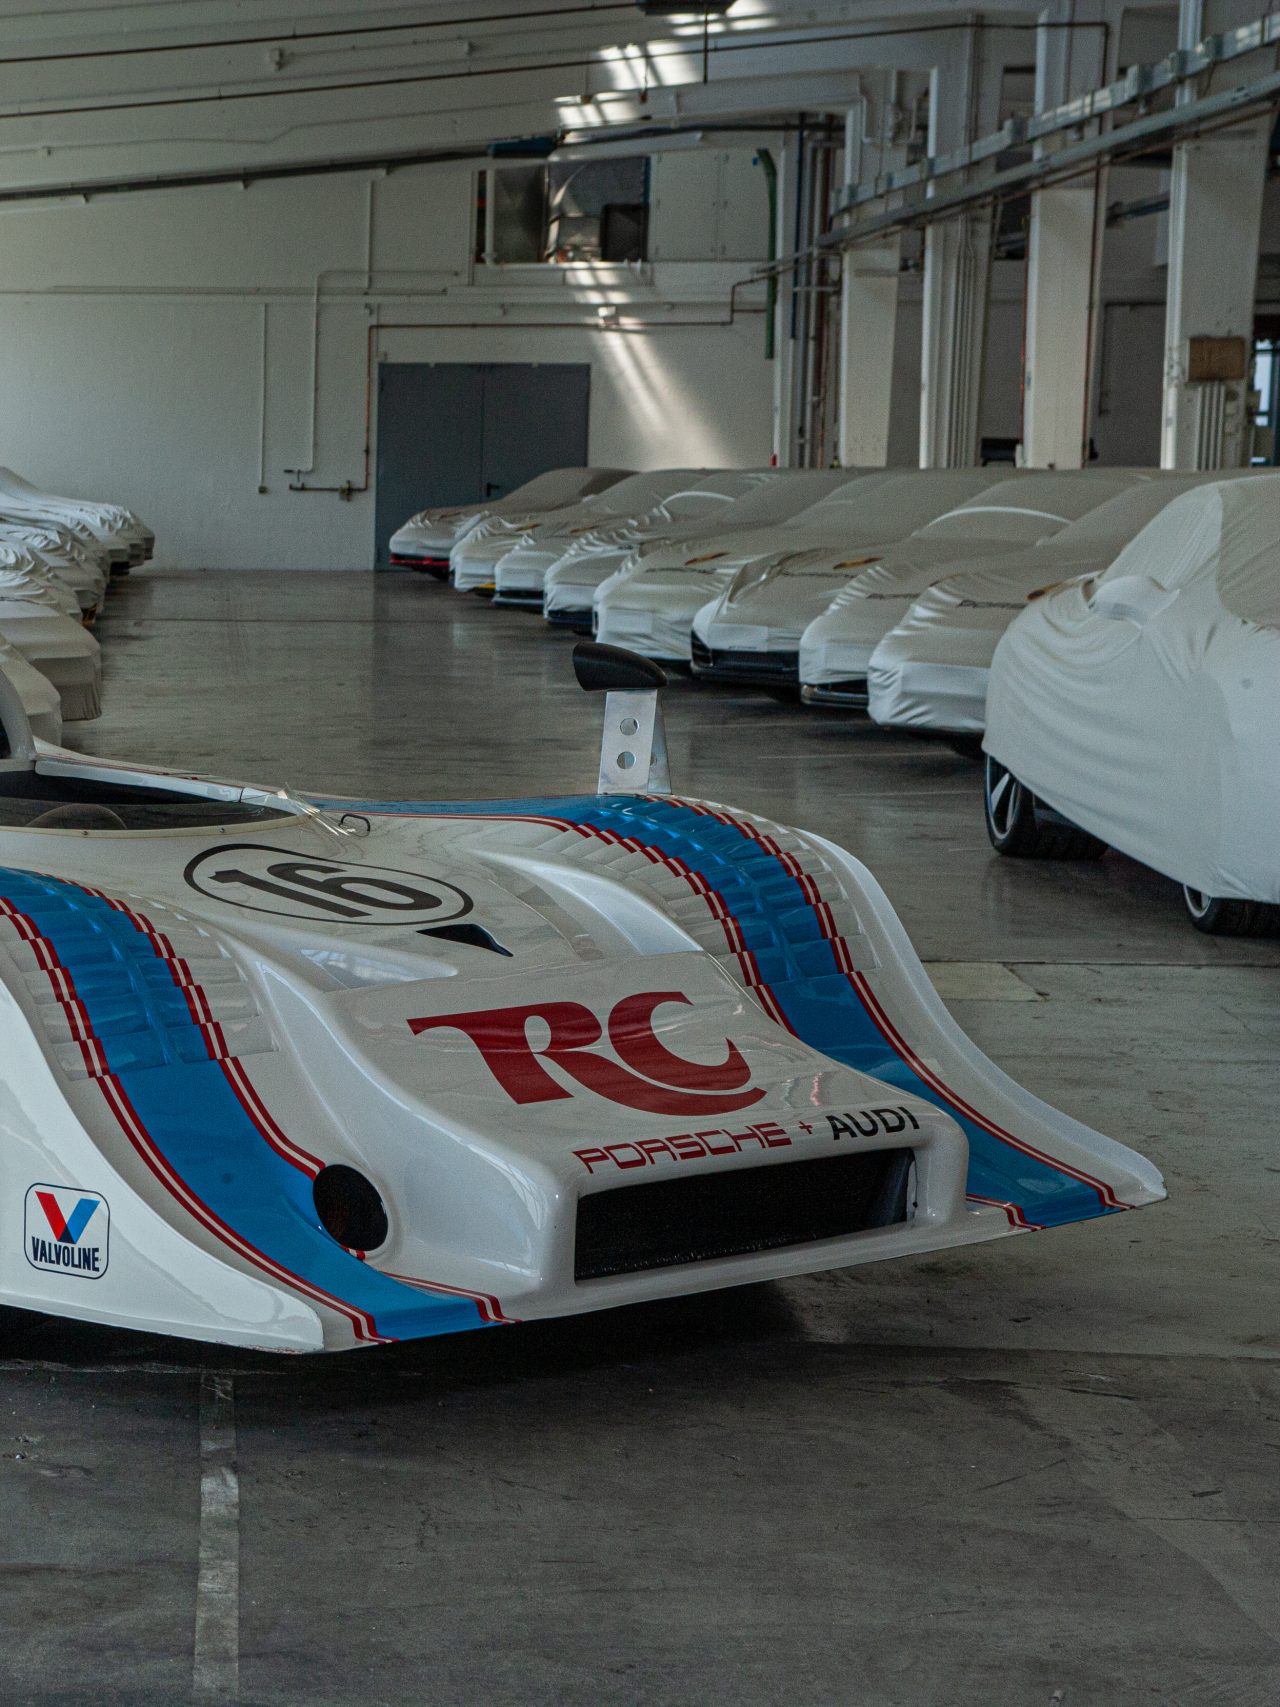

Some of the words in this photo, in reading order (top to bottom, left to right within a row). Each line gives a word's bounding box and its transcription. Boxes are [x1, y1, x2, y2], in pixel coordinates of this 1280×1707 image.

[207, 862, 443, 918] 16
[406, 991, 768, 1117] RC
[572, 1121, 793, 1175] PORSCHE
[826, 1105, 920, 1141] AUDI
[31, 1236, 100, 1272] VALVOLINE
